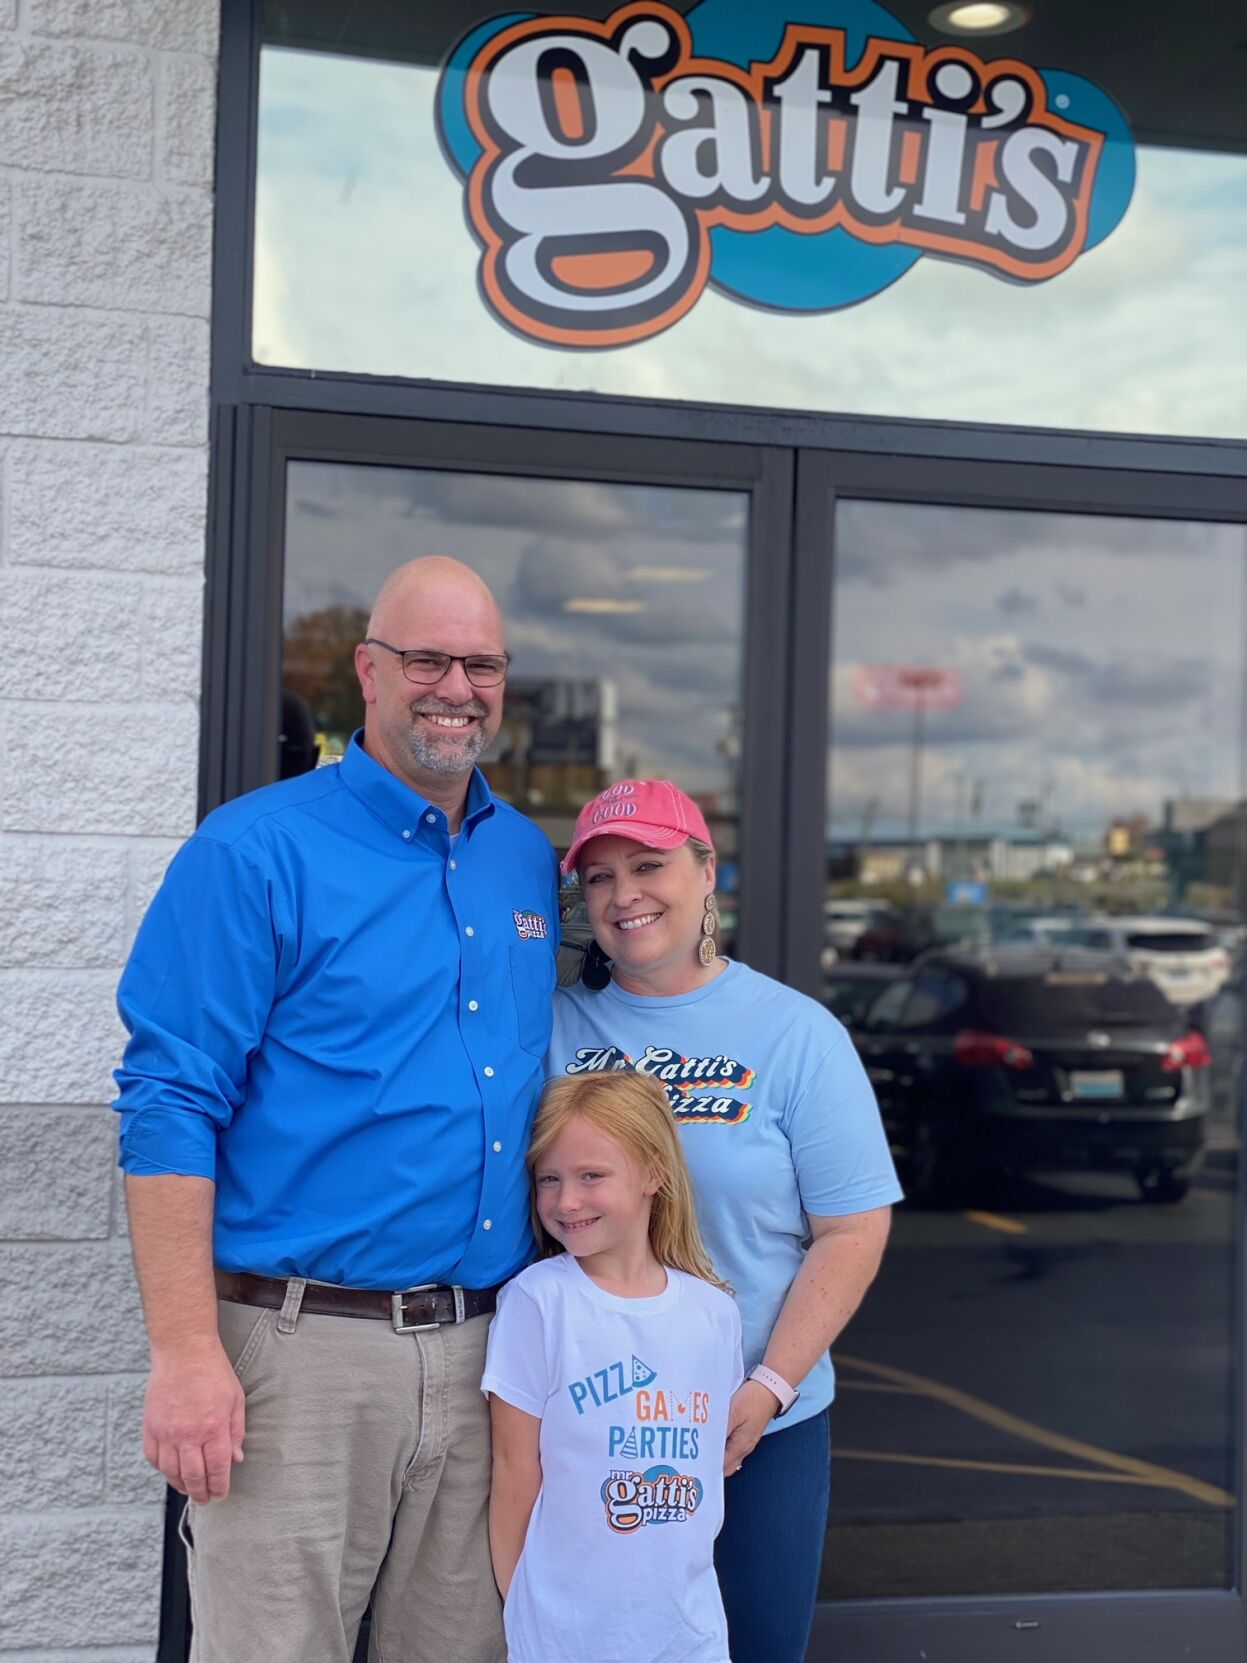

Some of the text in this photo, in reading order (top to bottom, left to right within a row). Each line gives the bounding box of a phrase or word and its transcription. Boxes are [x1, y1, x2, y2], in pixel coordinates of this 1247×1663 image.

[487, 20, 1078, 311] gatti's
[635, 1046, 737, 1079] Gatti's
[636, 1390, 709, 1424] GAMES
[608, 1426, 699, 1459] PARTIES
[610, 1470, 632, 1480] mr
[608, 1475, 697, 1528] gatti's
[642, 1503, 686, 1526] pizza
